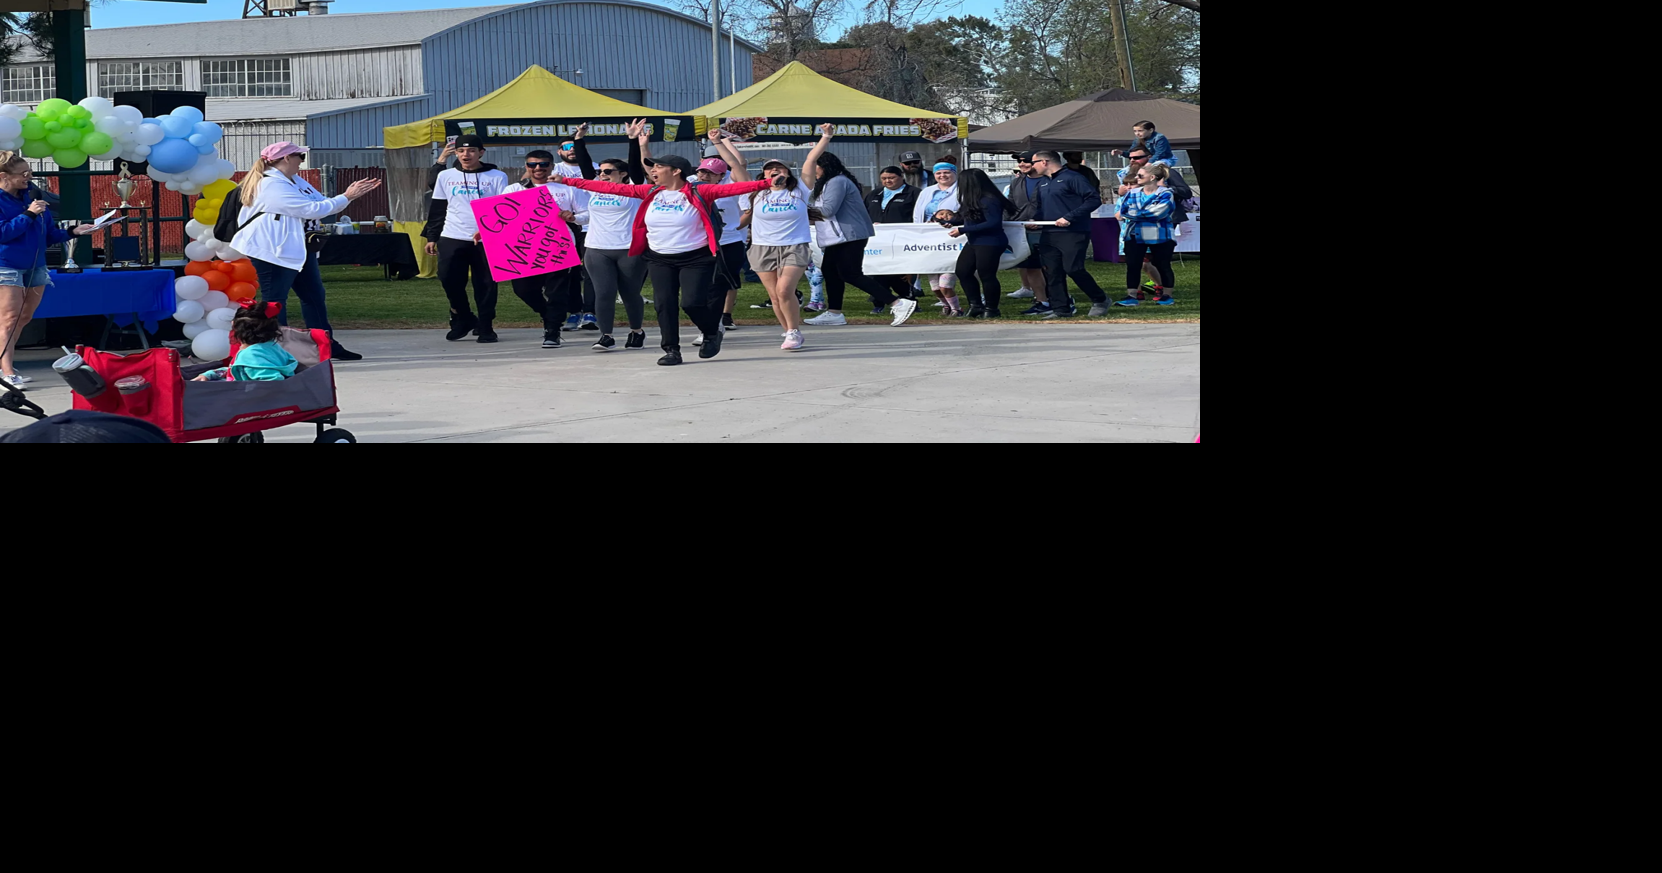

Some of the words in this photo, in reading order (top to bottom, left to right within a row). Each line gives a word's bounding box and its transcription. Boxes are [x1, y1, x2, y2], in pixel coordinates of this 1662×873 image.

[487, 125, 555, 137] FROZEN
[557, 123, 655, 137] LEONAE
[756, 124, 812, 136] CARNE
[814, 124, 872, 136] AADA
[873, 125, 921, 136] FRIES
[494, 189, 553, 275] WARRIORS
[904, 243, 957, 252] Adventist
